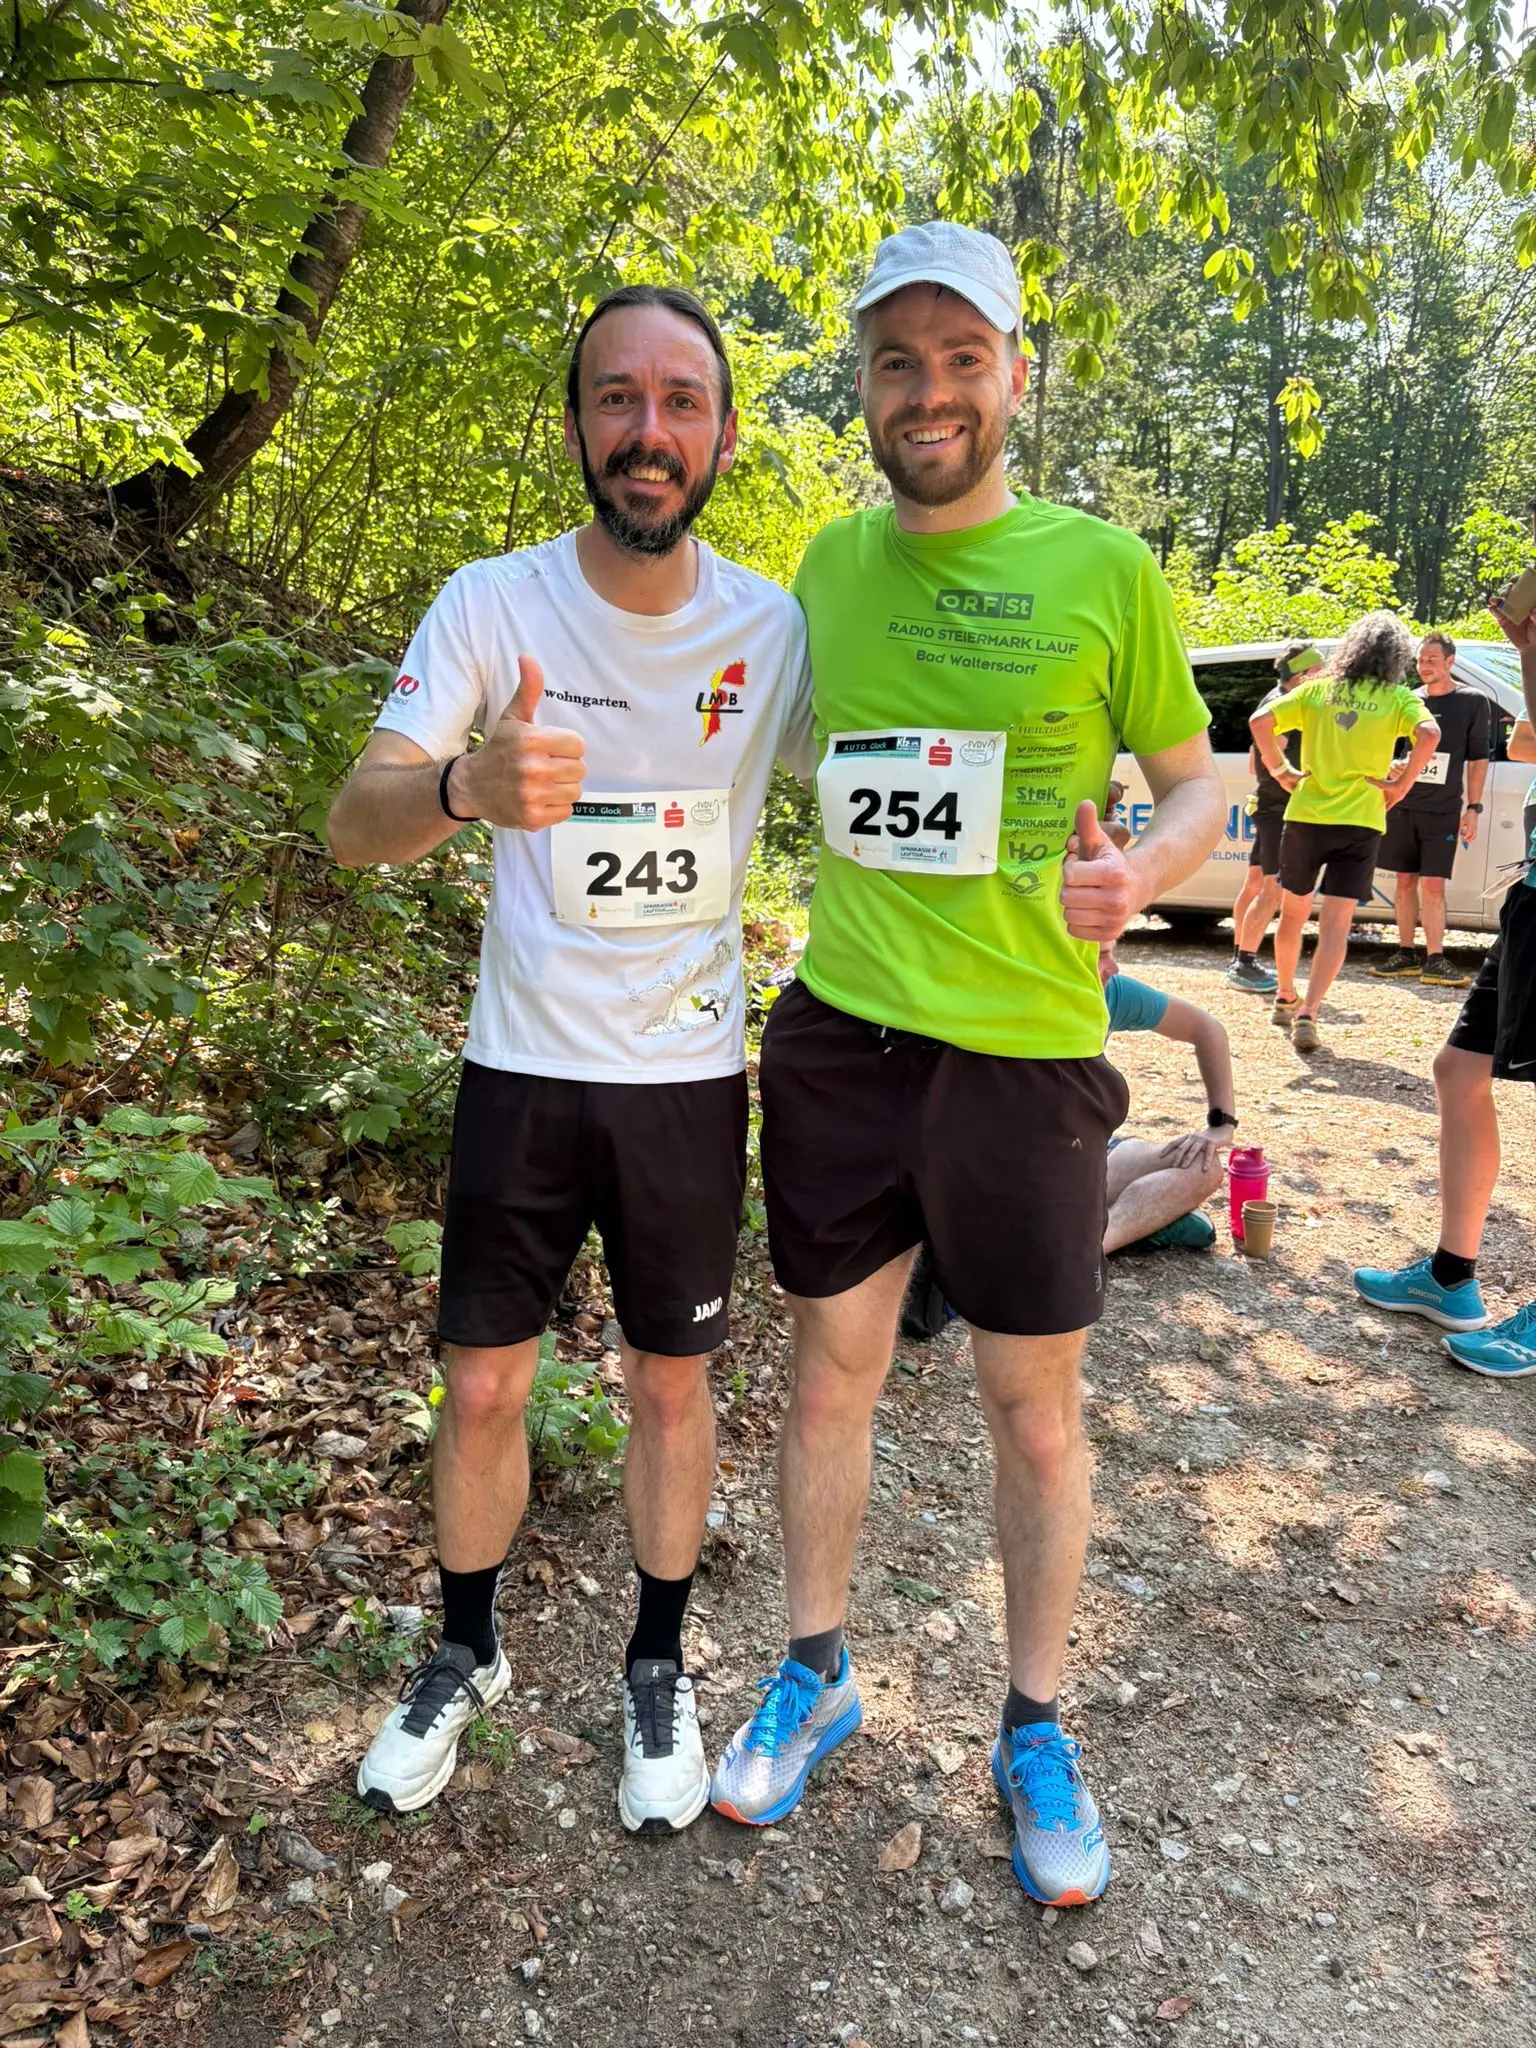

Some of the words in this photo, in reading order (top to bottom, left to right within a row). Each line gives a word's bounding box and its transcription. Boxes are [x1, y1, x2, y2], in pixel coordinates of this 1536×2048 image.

[942, 595, 999, 613] ORF
[1005, 598, 1030, 615] St
[888, 621, 934, 639] RADIO
[938, 628, 1032, 650] STEIERMARK
[1035, 639, 1080, 655] LAUF
[916, 649, 946, 664] Bad
[949, 654, 1038, 676] Waltersdorf
[843, 743, 867, 752] AUTO
[869, 742, 887, 750] Glock
[600, 807, 621, 815] Glock
[849, 788, 962, 841] 254
[1003, 818, 1059, 829] SPARKASSE
[586, 849, 699, 897] 243
